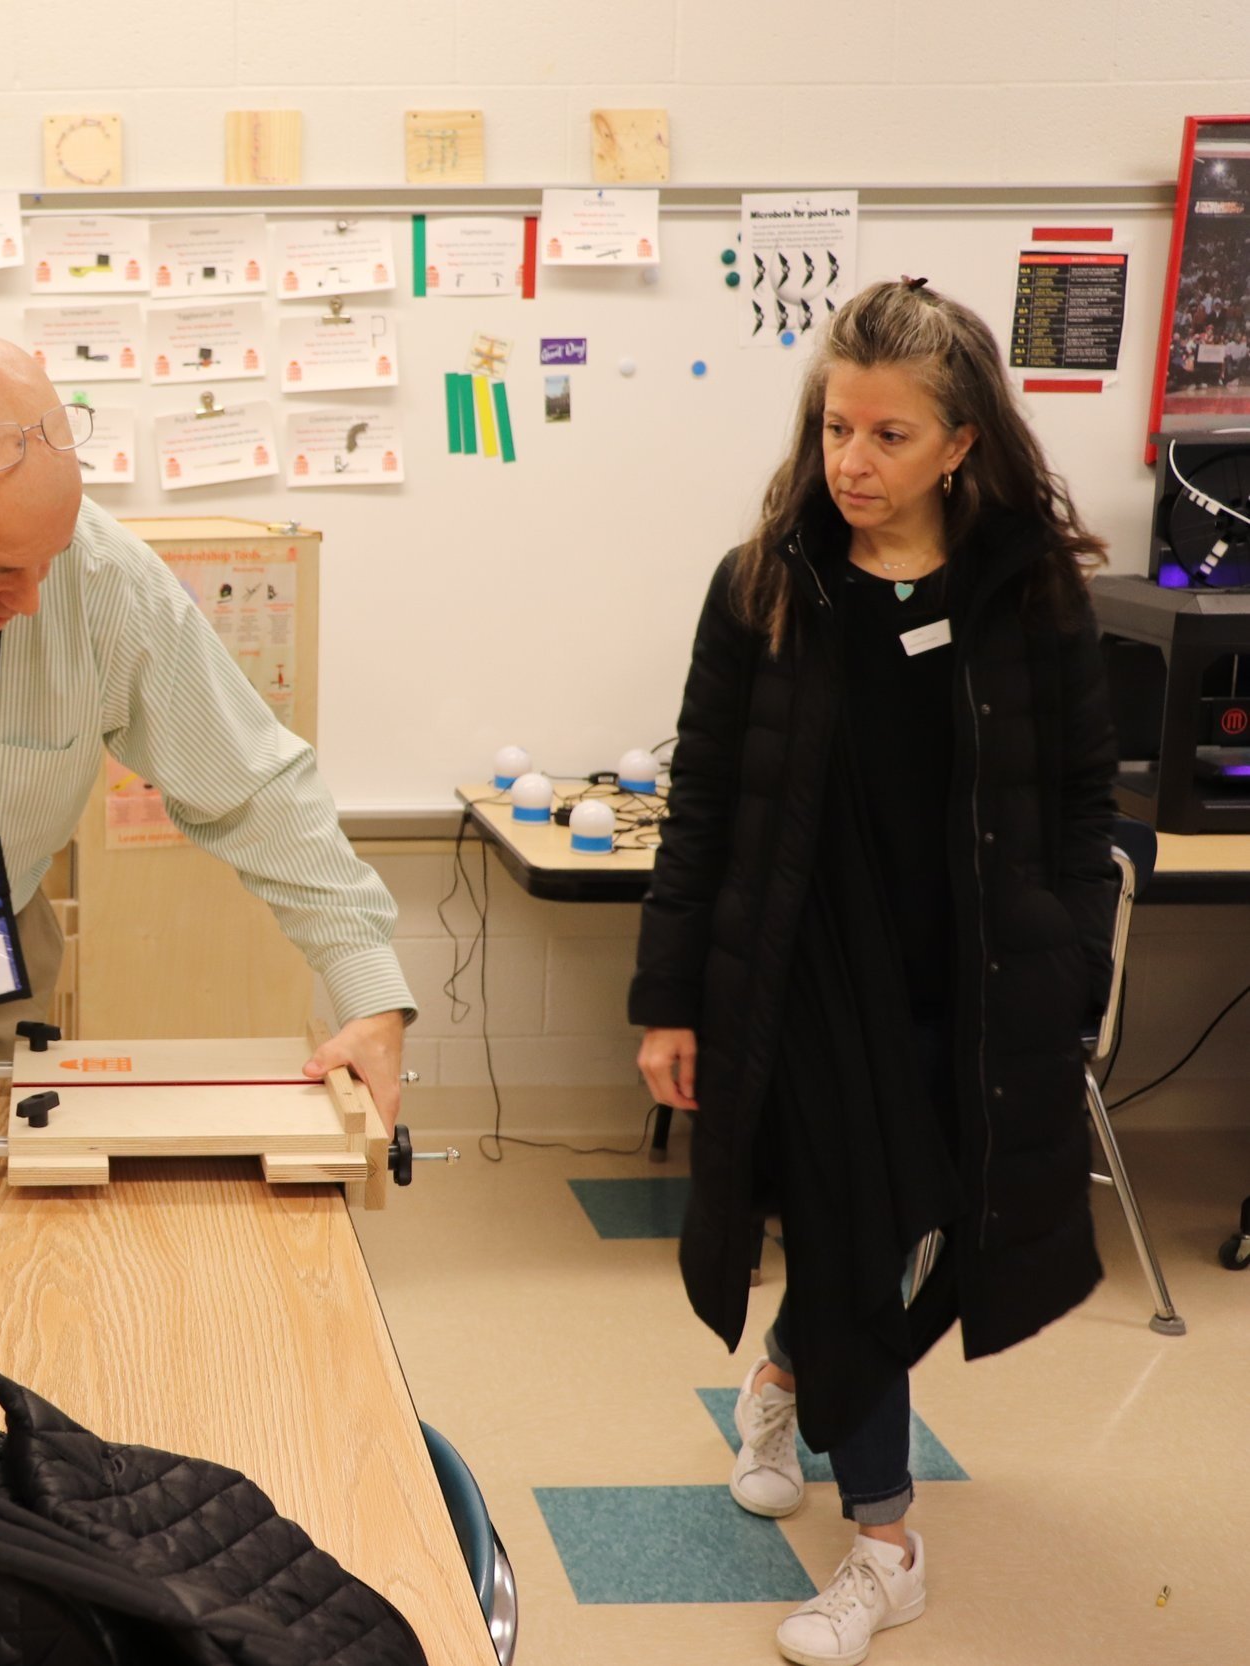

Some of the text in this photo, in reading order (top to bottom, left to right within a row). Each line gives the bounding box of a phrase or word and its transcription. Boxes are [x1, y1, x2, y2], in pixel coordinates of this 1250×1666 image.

[750, 208, 851, 219] Microbots for good Tech
